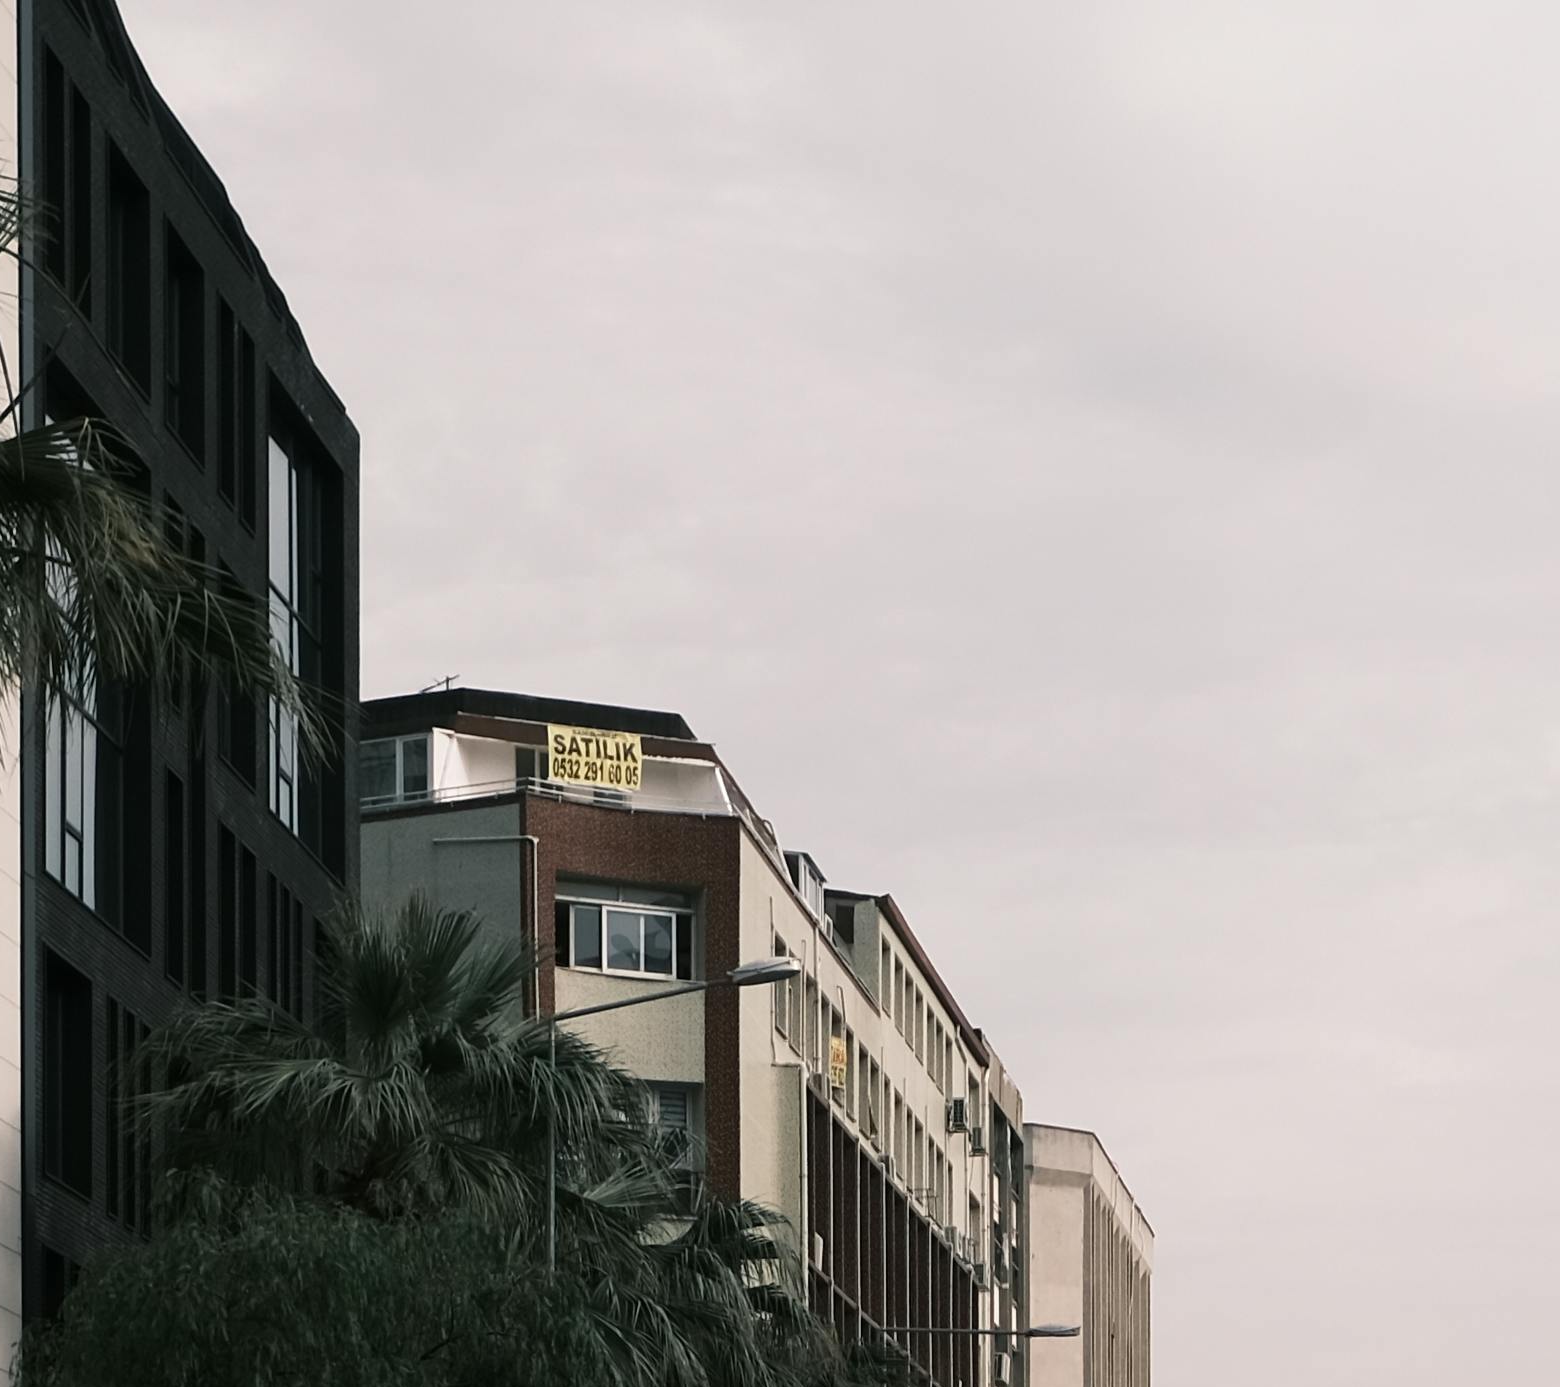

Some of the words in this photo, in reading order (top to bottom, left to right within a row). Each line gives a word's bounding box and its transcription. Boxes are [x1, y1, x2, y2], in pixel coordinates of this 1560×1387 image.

[553, 734, 638, 764] SATILIK
[553, 758, 580, 779] 0532
[584, 761, 604, 782] 291
[625, 766, 639, 785] 05
